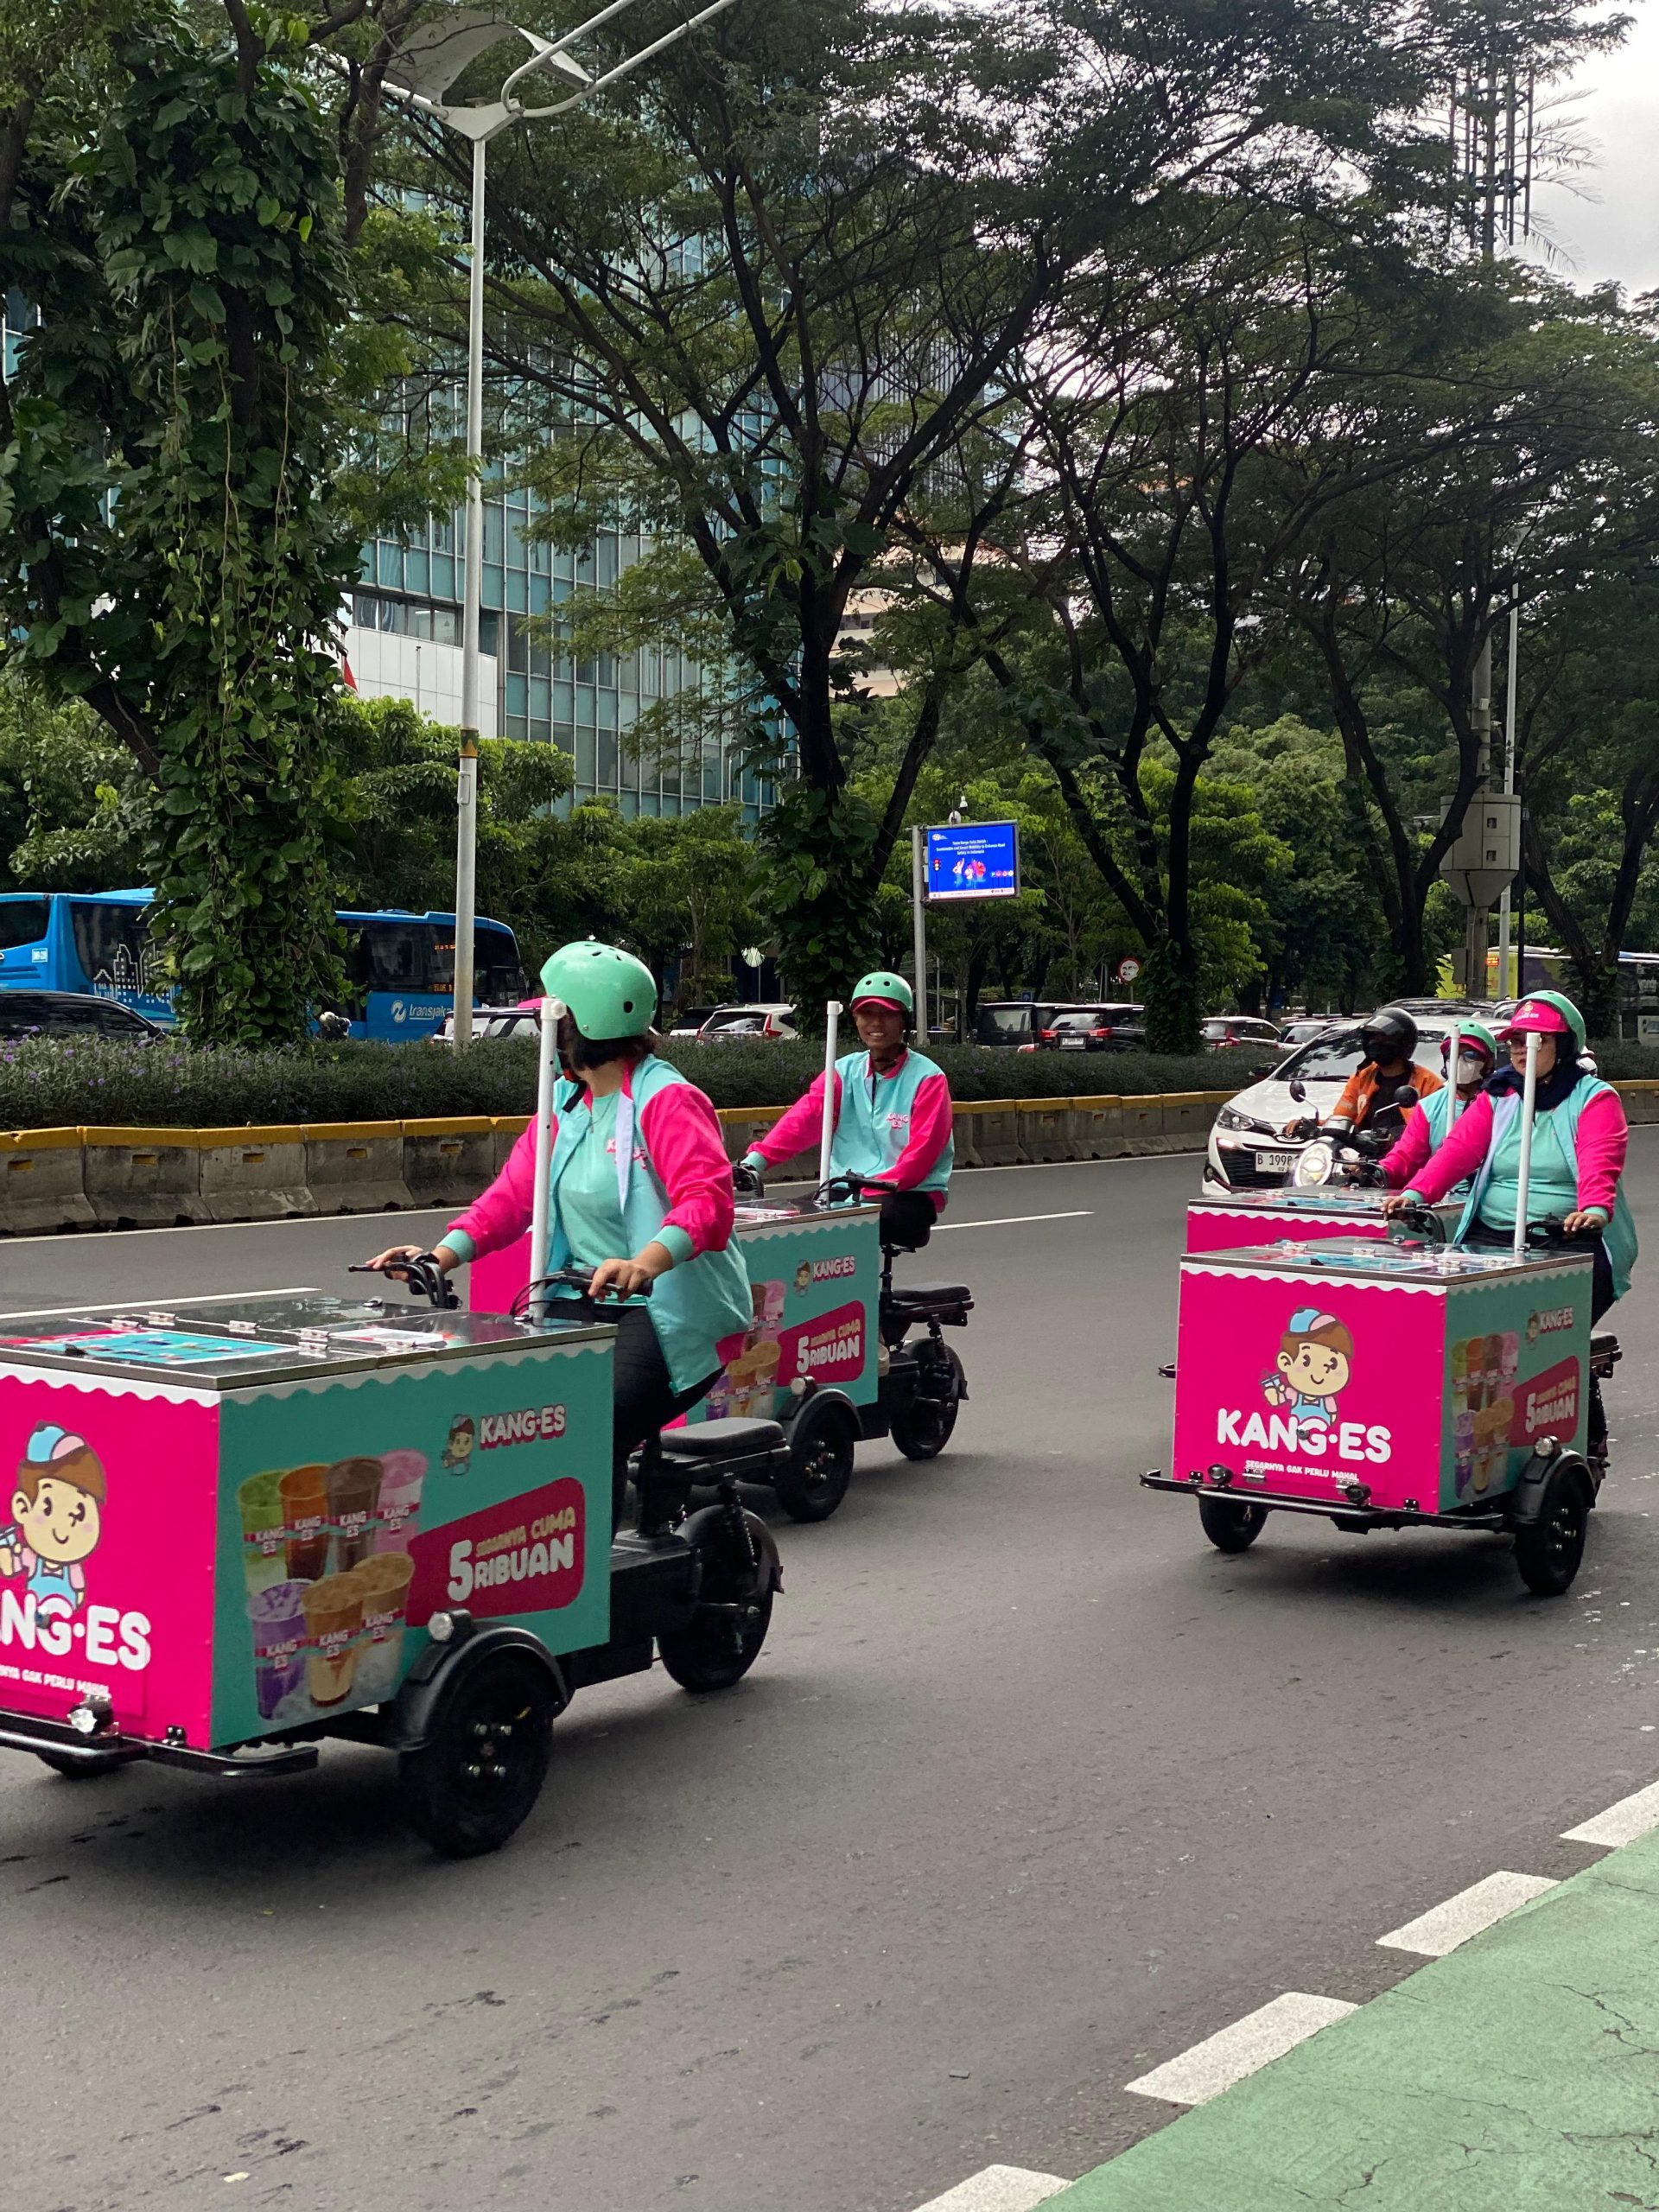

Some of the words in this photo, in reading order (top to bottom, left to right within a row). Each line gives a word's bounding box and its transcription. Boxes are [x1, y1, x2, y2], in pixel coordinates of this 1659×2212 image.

[1257, 1154, 1263, 1165] B
[1305, 1467, 1329, 1478] PERLU
[294, 1516, 322, 1530] KANG
[340, 1510, 367, 1526] KANG
[531, 1506, 576, 1539] CUMA
[346, 1525, 359, 1538] ES
[447, 1539, 474, 1601] 5
[474, 1532, 575, 1590] RIBUAN
[319, 1630, 349, 1647] KANG
[266, 1638, 298, 1656] KANG
[43, 1673, 75, 1691] PERLU
